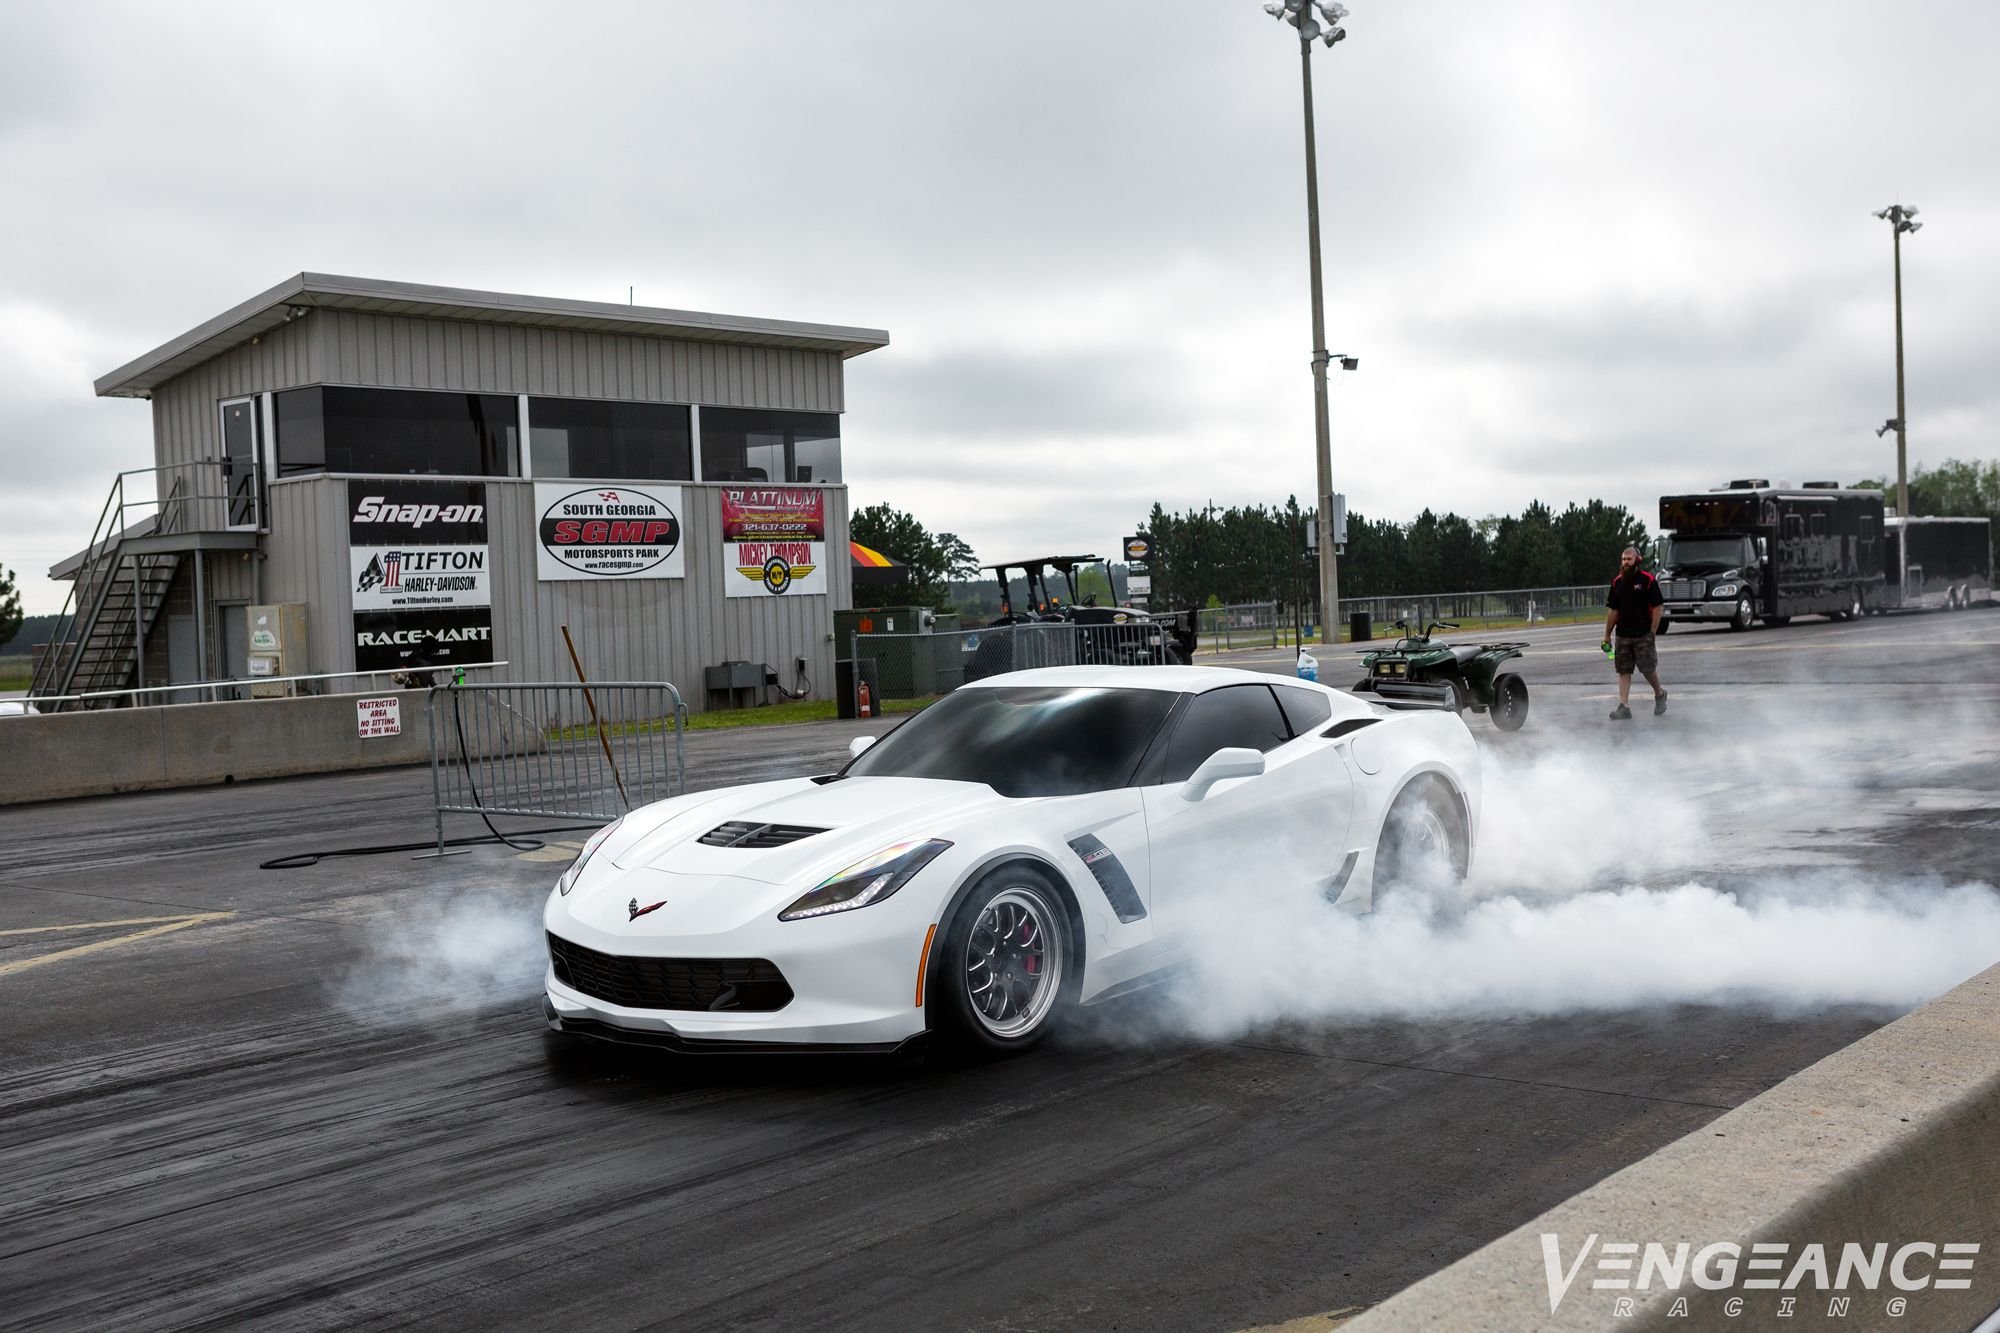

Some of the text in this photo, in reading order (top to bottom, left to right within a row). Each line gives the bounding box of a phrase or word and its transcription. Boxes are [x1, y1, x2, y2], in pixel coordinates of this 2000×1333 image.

[730, 491, 816, 505] PLATTINUM
[353, 497, 483, 528] Snap-on
[563, 504, 656, 516] SOUTH GEORGIA
[553, 520, 670, 544] SGMP
[564, 549, 659, 559] MOTORSPORTS PARK
[739, 543, 811, 566] MICKEY THOMPSON
[402, 551, 483, 570] TIFTON
[585, 561, 643, 569] www.racesgmp.com
[404, 576, 476, 592] HARLEY-DAVIDSON
[392, 595, 454, 605] www.TiftonHarley.com
[357, 627, 490, 646] RACE-MART
[359, 699, 397, 709] RESTRICTED
[370, 709, 387, 717] AREA
[372, 718, 395, 726] SITTING
[384, 726, 399, 734] WALL
